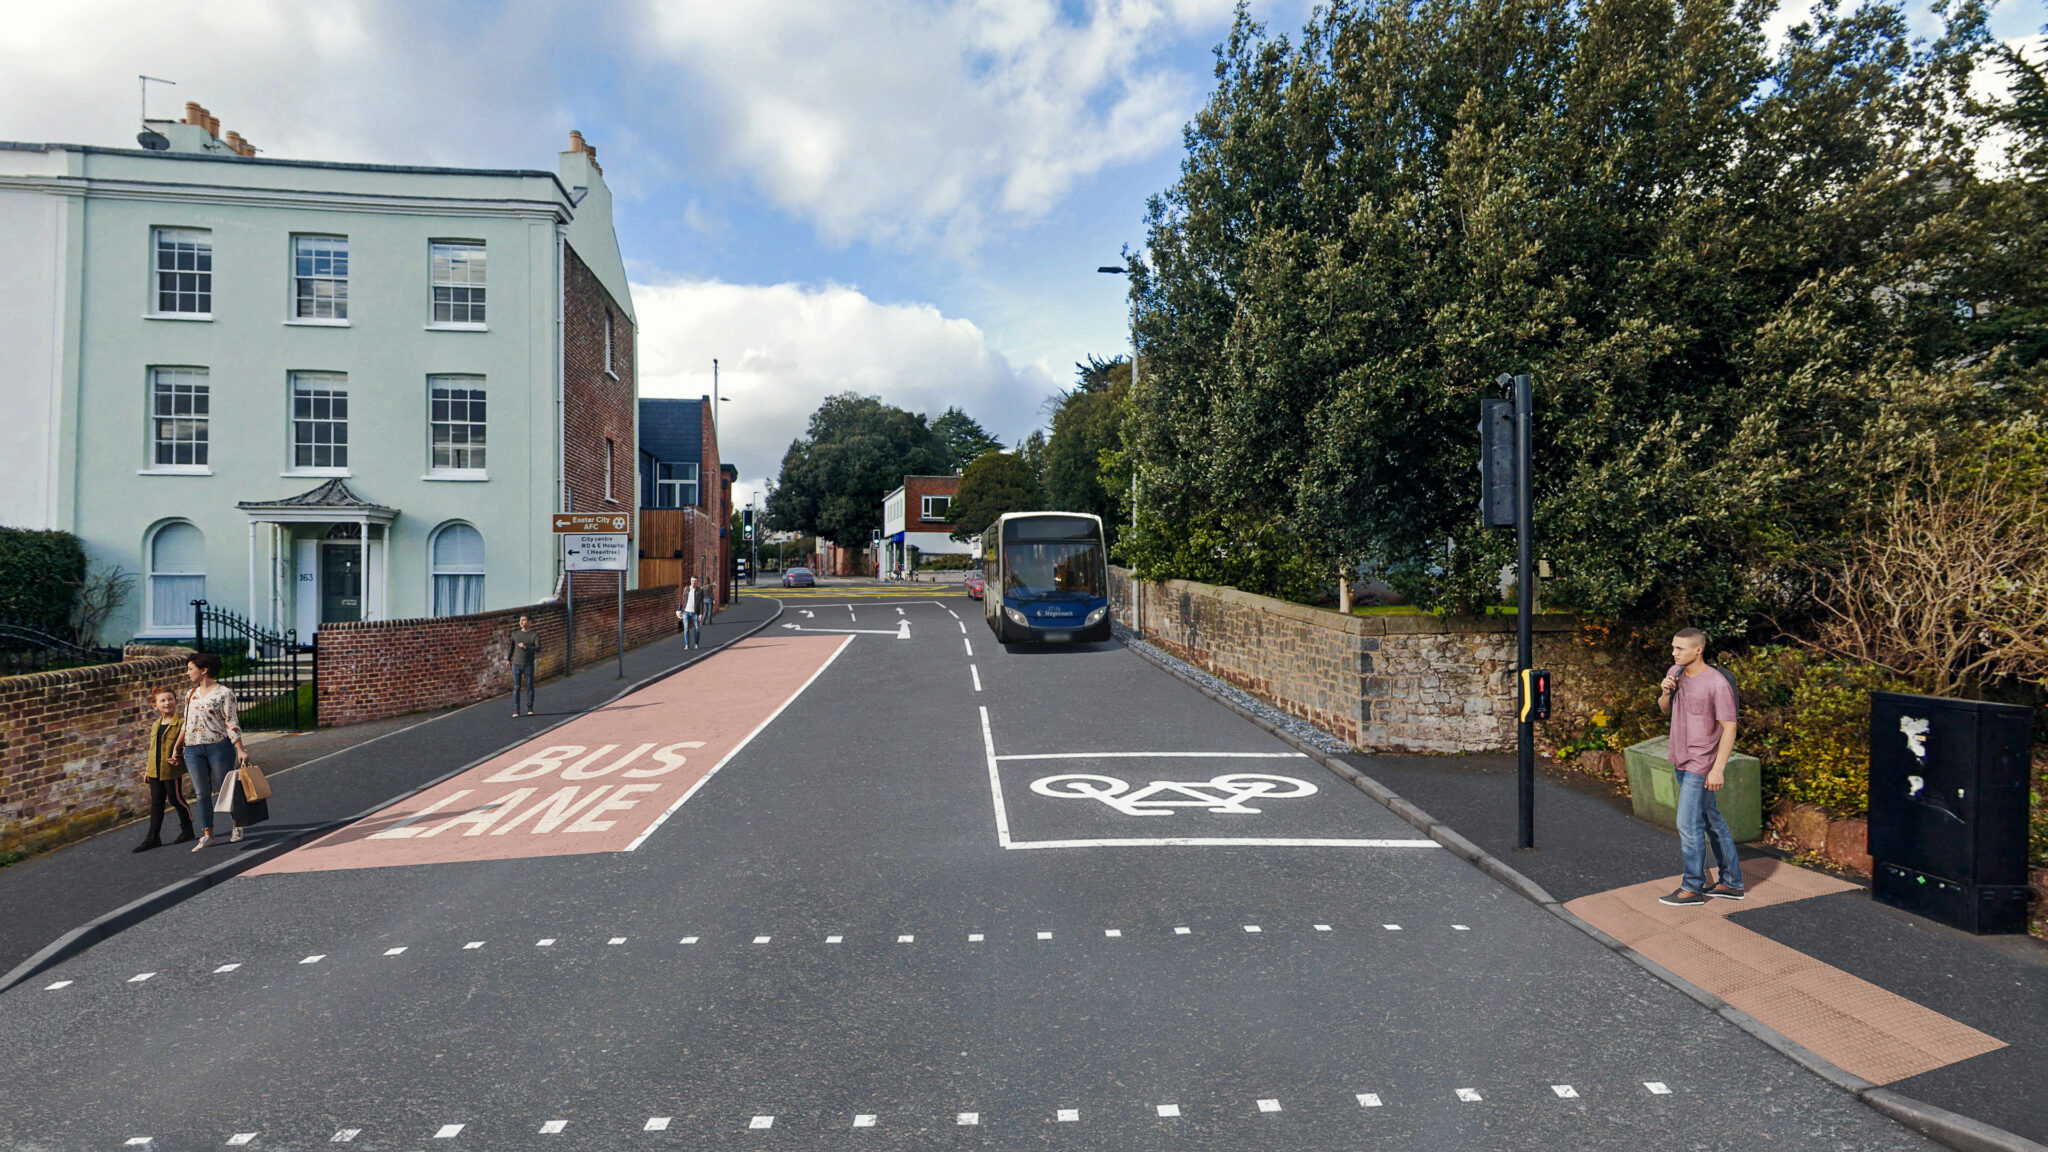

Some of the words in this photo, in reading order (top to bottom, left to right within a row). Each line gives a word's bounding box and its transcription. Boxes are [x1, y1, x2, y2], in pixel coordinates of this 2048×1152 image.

[572, 516, 595, 524] Exeter
[596, 516, 610, 524] City
[300, 573, 314, 581] 163
[480, 741, 707, 783] BUS
[365, 783, 662, 840] LANE
